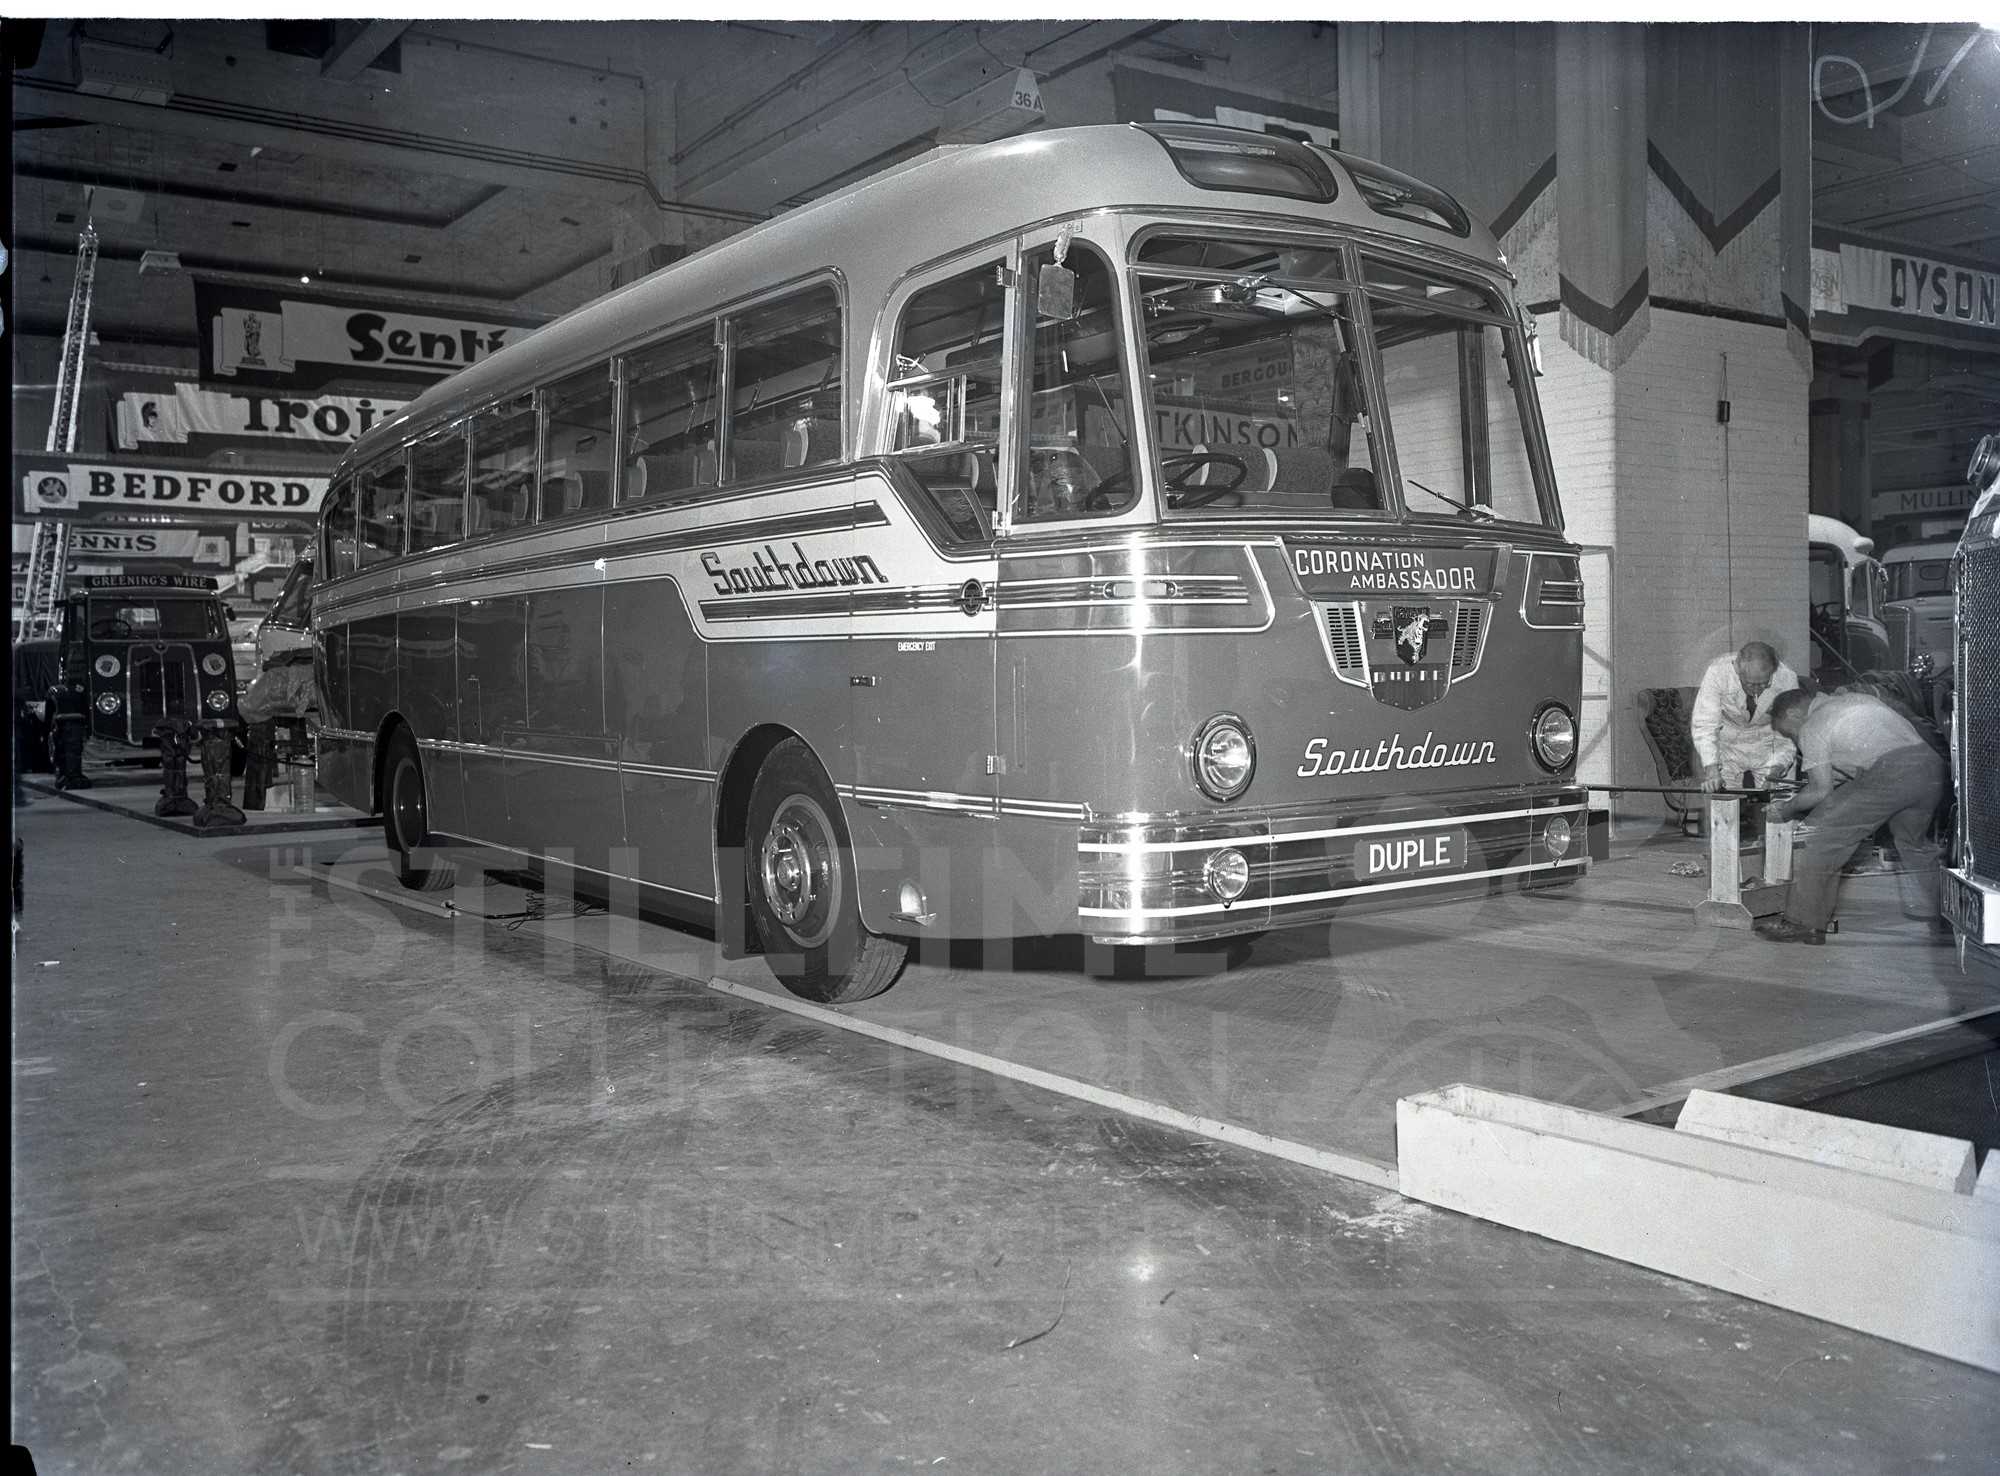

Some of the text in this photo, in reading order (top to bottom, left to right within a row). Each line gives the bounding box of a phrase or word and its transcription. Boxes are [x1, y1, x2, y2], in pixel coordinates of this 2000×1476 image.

[1015, 91, 1043, 110] 36A
[1890, 258, 1995, 323] DYSON
[89, 470, 310, 507] BEDFORD
[92, 575, 168, 586] GREENING'S
[700, 542, 888, 595] Southdown
[1295, 549, 1425, 576] CORONATION
[1350, 566, 1476, 591] AMBASSADOR
[1297, 732, 1496, 777] Southdown
[1369, 836, 1451, 873] DUPLE
